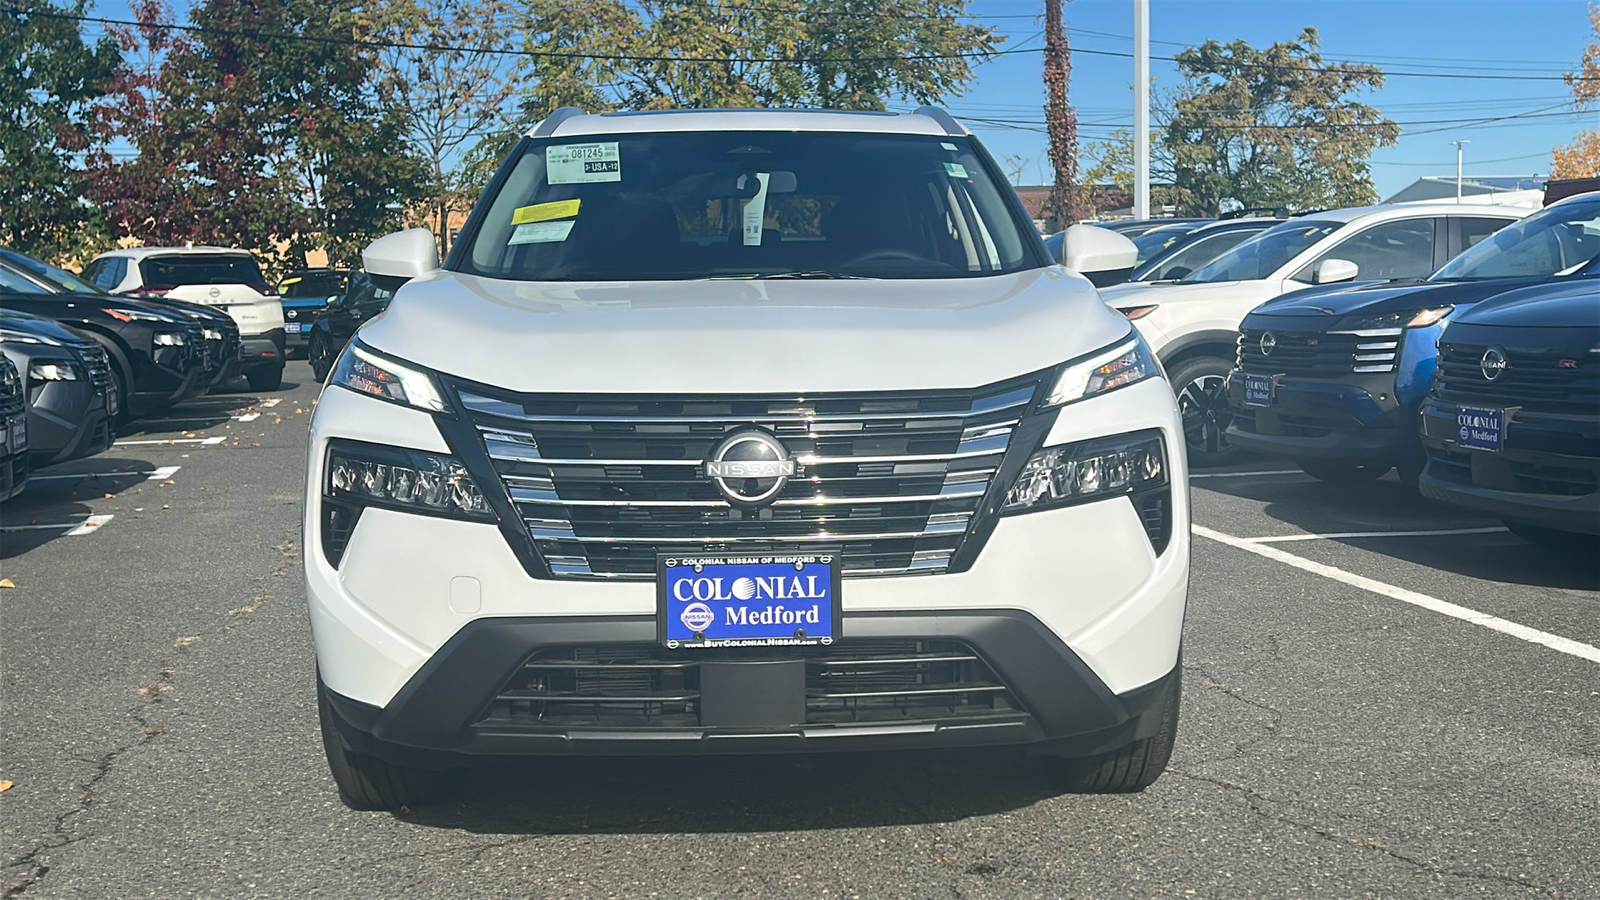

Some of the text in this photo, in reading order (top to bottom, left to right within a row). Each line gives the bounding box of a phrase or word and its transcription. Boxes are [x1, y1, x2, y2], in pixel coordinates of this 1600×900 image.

[571, 148, 603, 158] 081245
[592, 163, 607, 171] USA
[1457, 414, 1499, 430] COLONIAL
[1471, 429, 1498, 442] Medford
[708, 463, 792, 475] NISSAN
[682, 557, 726, 566] COLONIAL
[727, 556, 759, 564] NISSAN
[774, 556, 816, 564] MEDFORD
[673, 575, 826, 600] COLONIAL
[724, 604, 820, 626] Medford
